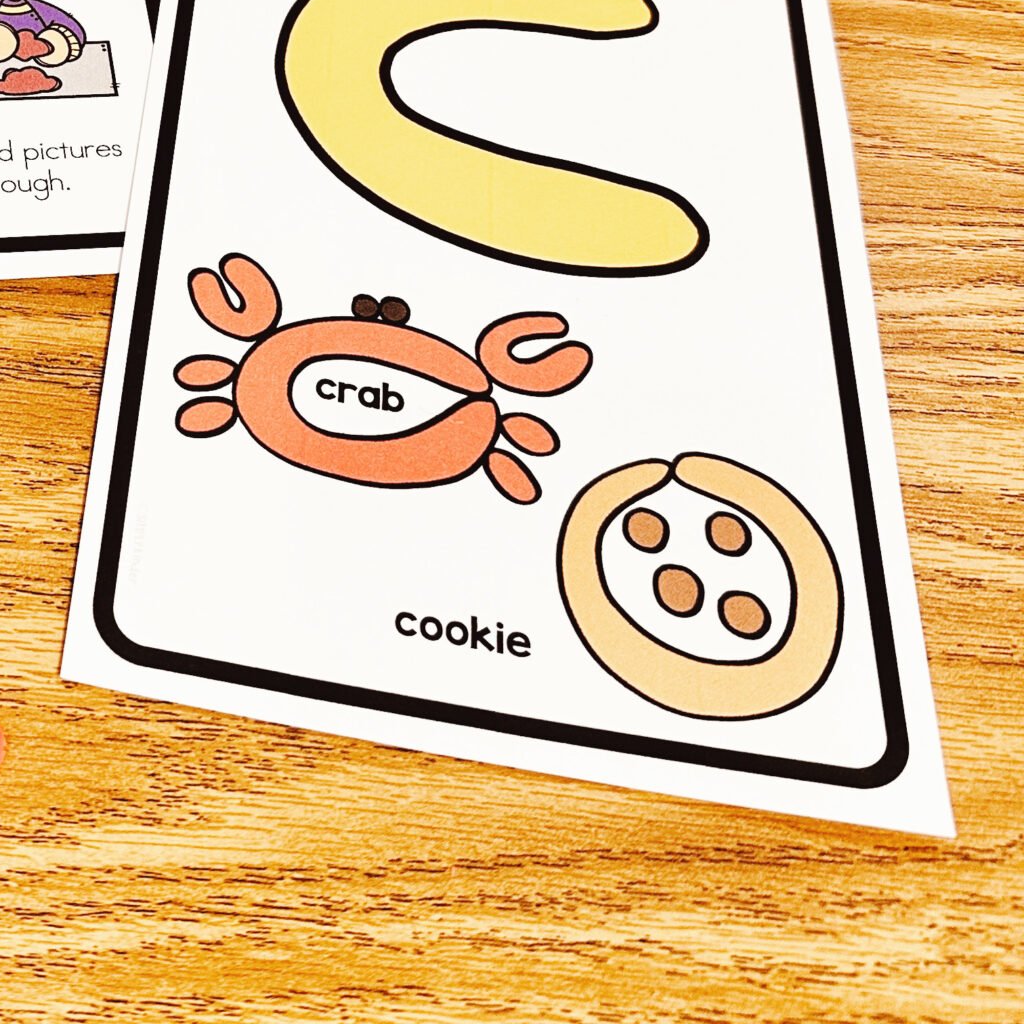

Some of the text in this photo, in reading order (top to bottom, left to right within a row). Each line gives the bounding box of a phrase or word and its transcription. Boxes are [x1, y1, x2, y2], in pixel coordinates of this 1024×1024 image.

[22, 140, 123, 169] pictures
[314, 375, 406, 413] crab
[394, 611, 532, 658] cookie
